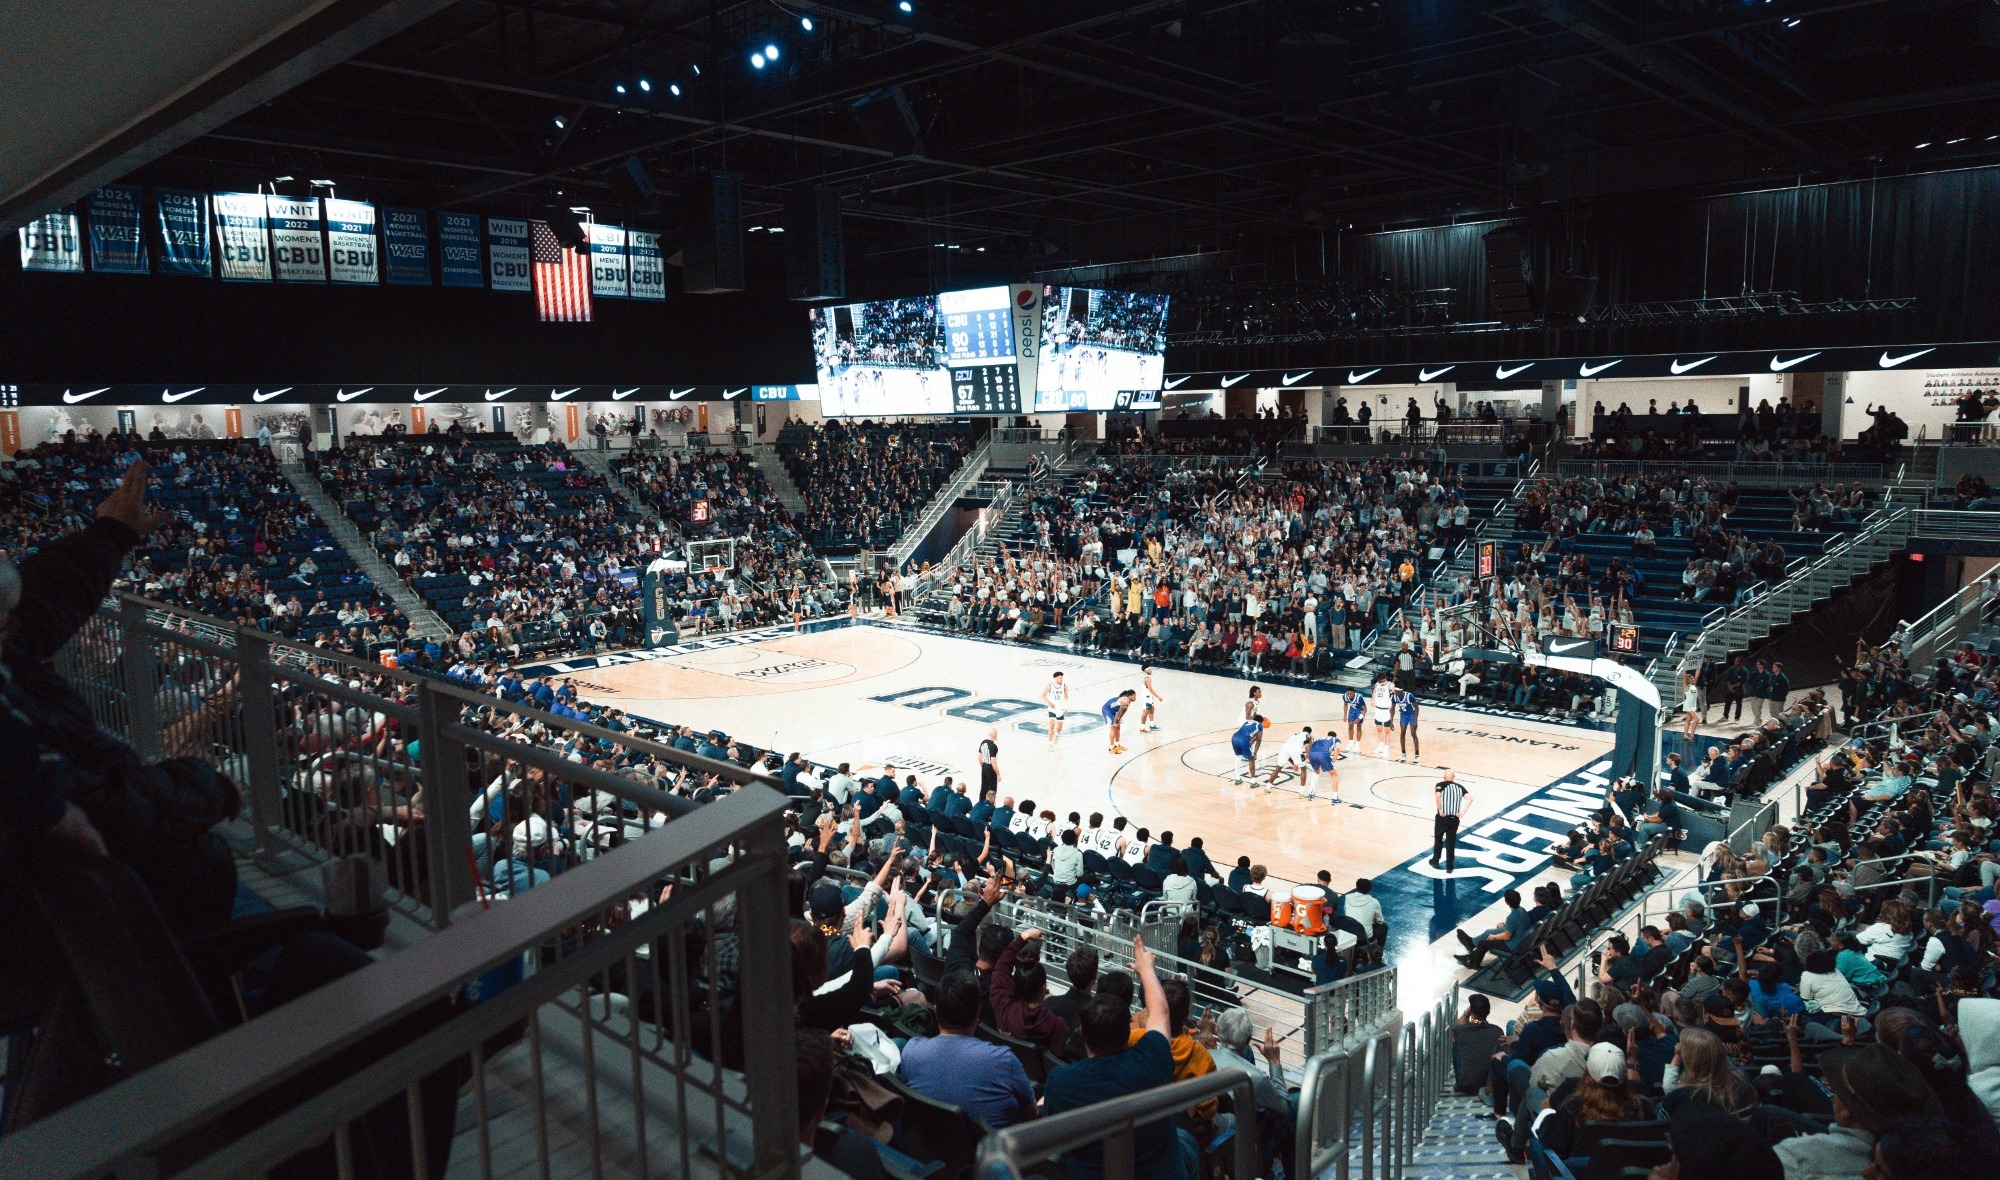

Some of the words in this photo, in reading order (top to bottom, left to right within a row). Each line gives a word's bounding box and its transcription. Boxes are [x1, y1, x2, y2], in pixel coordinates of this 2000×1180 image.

[97, 188, 132, 201] 2024
[95, 200, 134, 210] WOMEN'S
[165, 194, 198, 207] 2024
[275, 204, 315, 217] WNIT
[392, 212, 418, 223] 2021
[447, 216, 471, 227] 2021
[285, 220, 309, 229] 2022
[342, 223, 363, 232] 2021
[389, 223, 422, 231] WOMEN'S
[492, 223, 525, 235] WNIT
[95, 225, 140, 243] WAC
[443, 226, 475, 235] WOMEN'S
[26, 234, 77, 252] CBU
[275, 235, 320, 245] WOMEN'S
[337, 235, 370, 243] WOMEN'S
[440, 234, 480, 242] BASKETBALL
[500, 236, 519, 246] 2019
[224, 245, 267, 263] CBU
[390, 243, 426, 259] WAC
[445, 247, 478, 261] WAC
[601, 244, 618, 253] 2019
[277, 246, 321, 266] CBU
[333, 249, 374, 267] CBU
[493, 251, 528, 260] WOMEN'S
[599, 257, 621, 265] MEN'S
[493, 262, 528, 279] CBU
[637, 261, 658, 269] MEN'S
[277, 268, 325, 277] BASKETBALL
[594, 267, 627, 283] CBU
[632, 269, 664, 285] CBU
[492, 280, 531, 288] BASKETBALL
[594, 285, 629, 294] BASKETBALL
[951, 331, 970, 348] 80
[1019, 315, 1036, 359] pepsi
[979, 349, 987, 357] 20
[955, 370, 974, 381] GCU
[982, 367, 988, 375] 2
[1008, 366, 1013, 374] 4
[995, 375, 1003, 383] 10
[1008, 375, 1014, 383] 2
[1926, 373, 1950, 382] Student
[1951, 371, 1975, 380] Athlete
[758, 387, 787, 400] CBU
[957, 385, 975, 401] 67
[1010, 384, 1015, 392] 4
[1010, 393, 1016, 401] 2
[1070, 392, 1086, 407] 80
[1116, 392, 1131, 407] 67
[1138, 390, 1156, 403] GCU
[984, 403, 993, 411] 21
[998, 402, 1005, 411] 11
[1011, 401, 1017, 410] 0
[694, 509, 707, 521] 30
[1480, 556, 1492, 575] 30
[654, 586, 666, 621] CBU
[1620, 628, 1636, 638] 1:29
[1617, 637, 1632, 650] 30
[550, 629, 800, 674] LANCERS
[1685, 653, 1703, 662] LANCE
[1688, 660, 1698, 668] UP!
[860, 685, 1113, 738] CBU
[1436, 726, 1581, 752] #LANCEUP
[1012, 817, 1022, 827] 12
[1032, 825, 1039, 835] 4
[1080, 834, 1090, 845] 14
[1099, 839, 1112, 851] 42
[1128, 845, 1140, 857] 10
[1273, 903, 1282, 912] G
[1295, 903, 1308, 917] G
